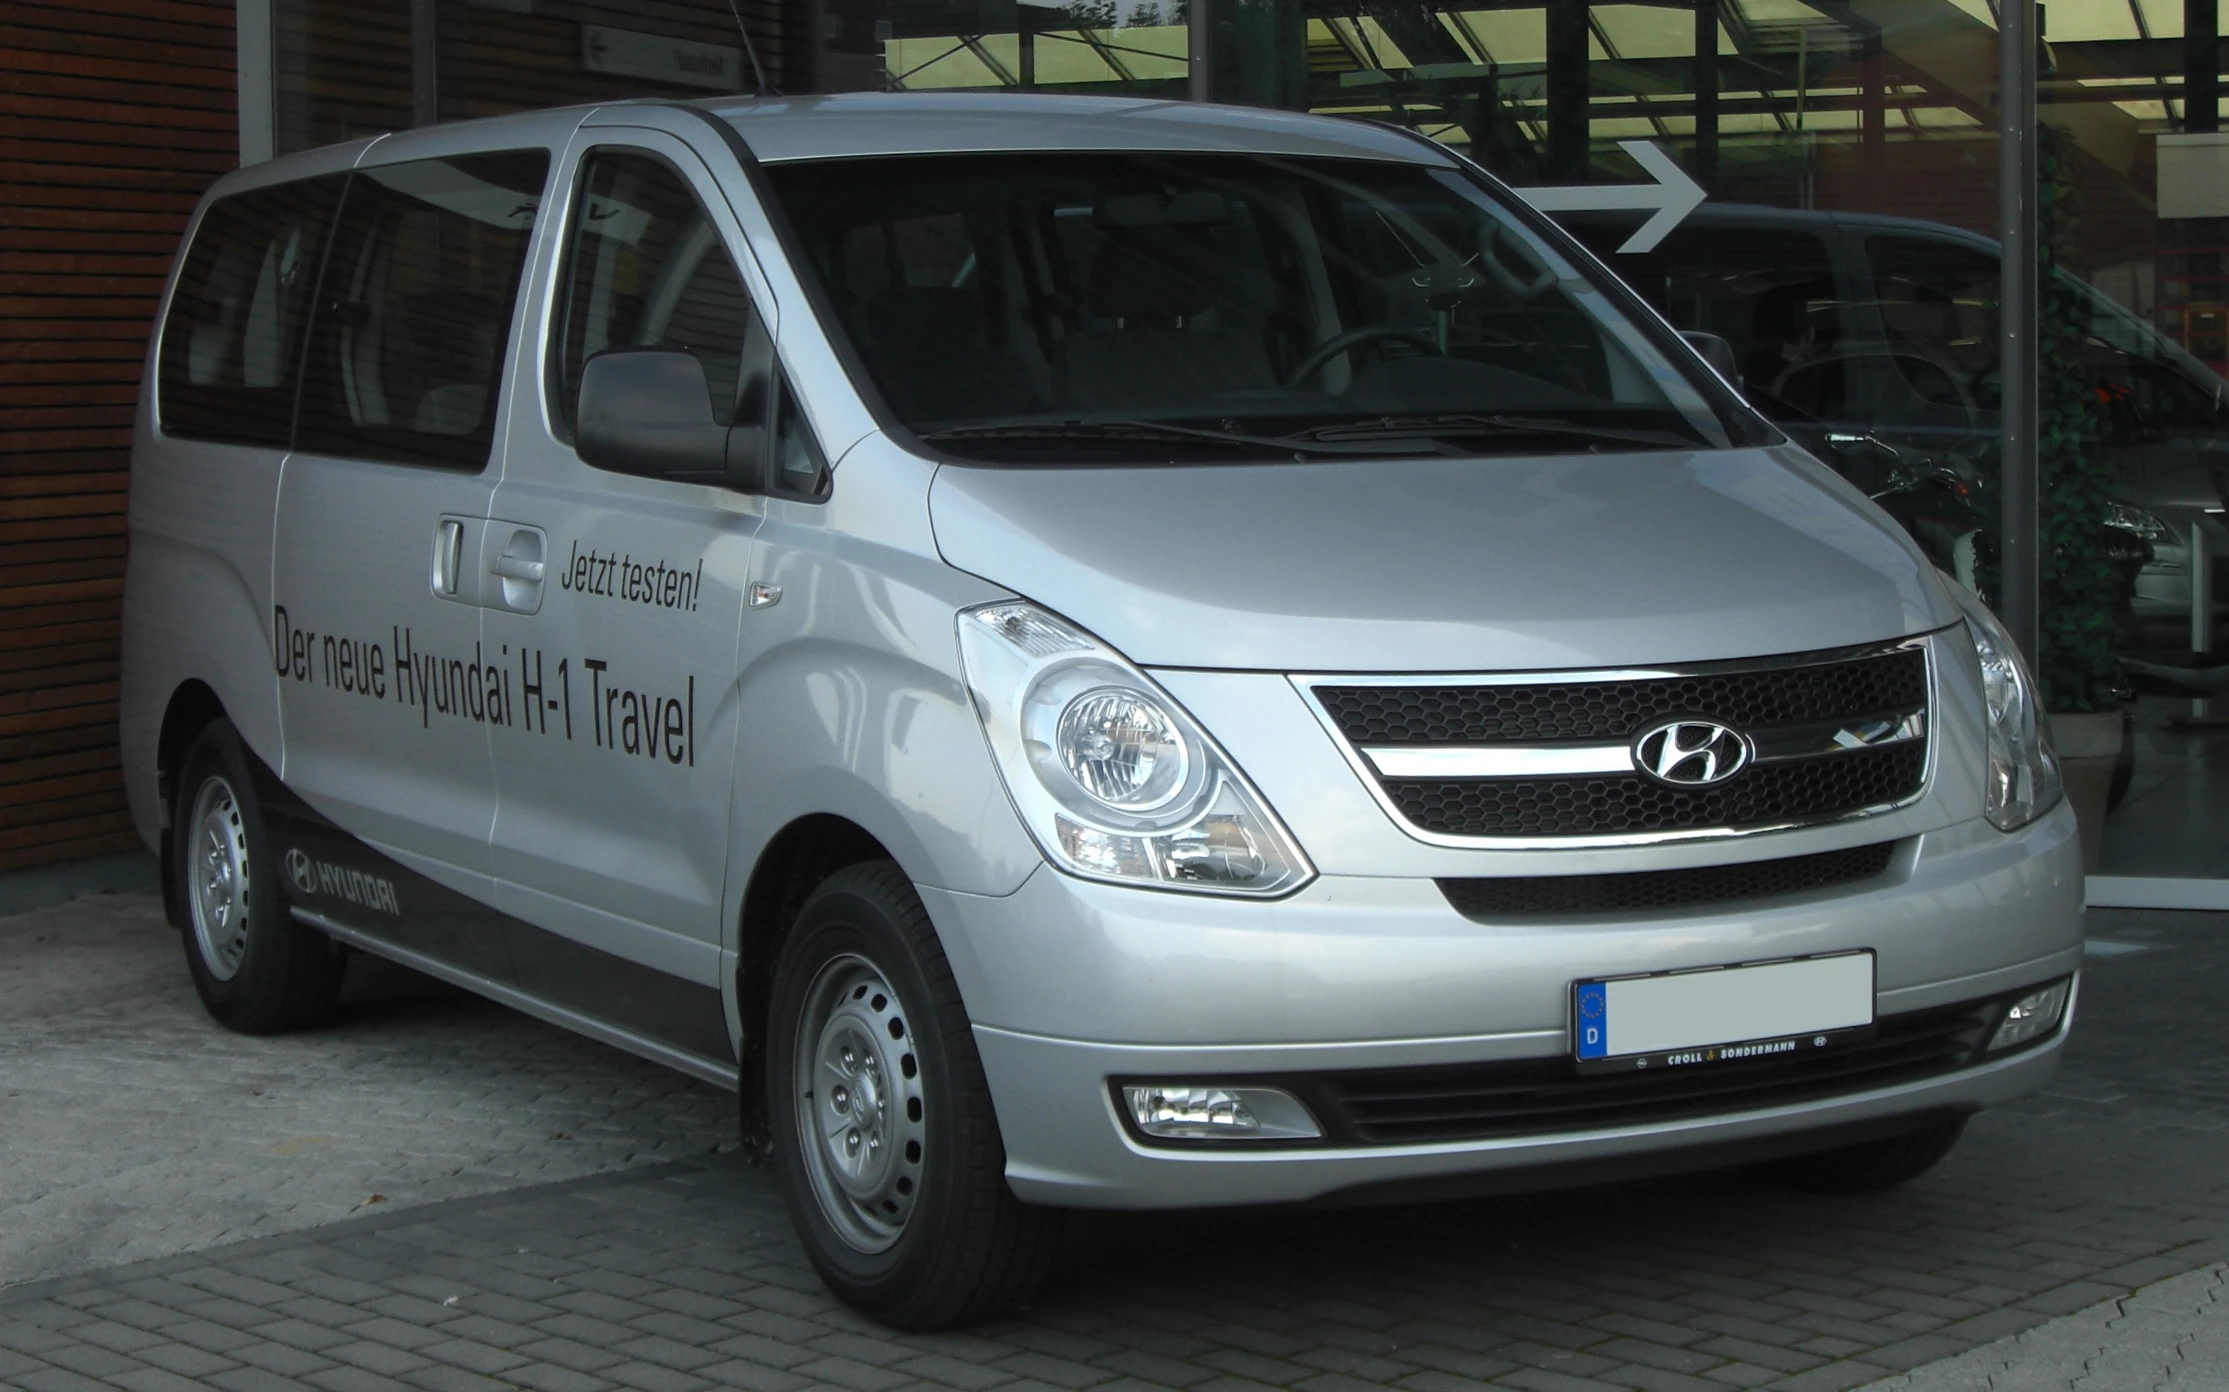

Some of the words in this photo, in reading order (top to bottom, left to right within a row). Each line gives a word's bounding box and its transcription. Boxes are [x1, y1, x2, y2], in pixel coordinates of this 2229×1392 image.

[561, 540, 617, 598] Jetzt
[620, 553, 703, 612] testen!
[274, 605, 315, 683] Der
[323, 634, 386, 699] neue
[393, 625, 512, 728] Hyundai
[521, 647, 572, 740] H-1
[584, 658, 695, 767] Travel
[316, 860, 400, 916] HYUNDAI
[1586, 1028, 1599, 1045] D
[1667, 1053, 1702, 1066] CROLL
[1706, 1052, 1716, 1062] &
[1720, 1041, 1796, 1060] SONDERMANN
